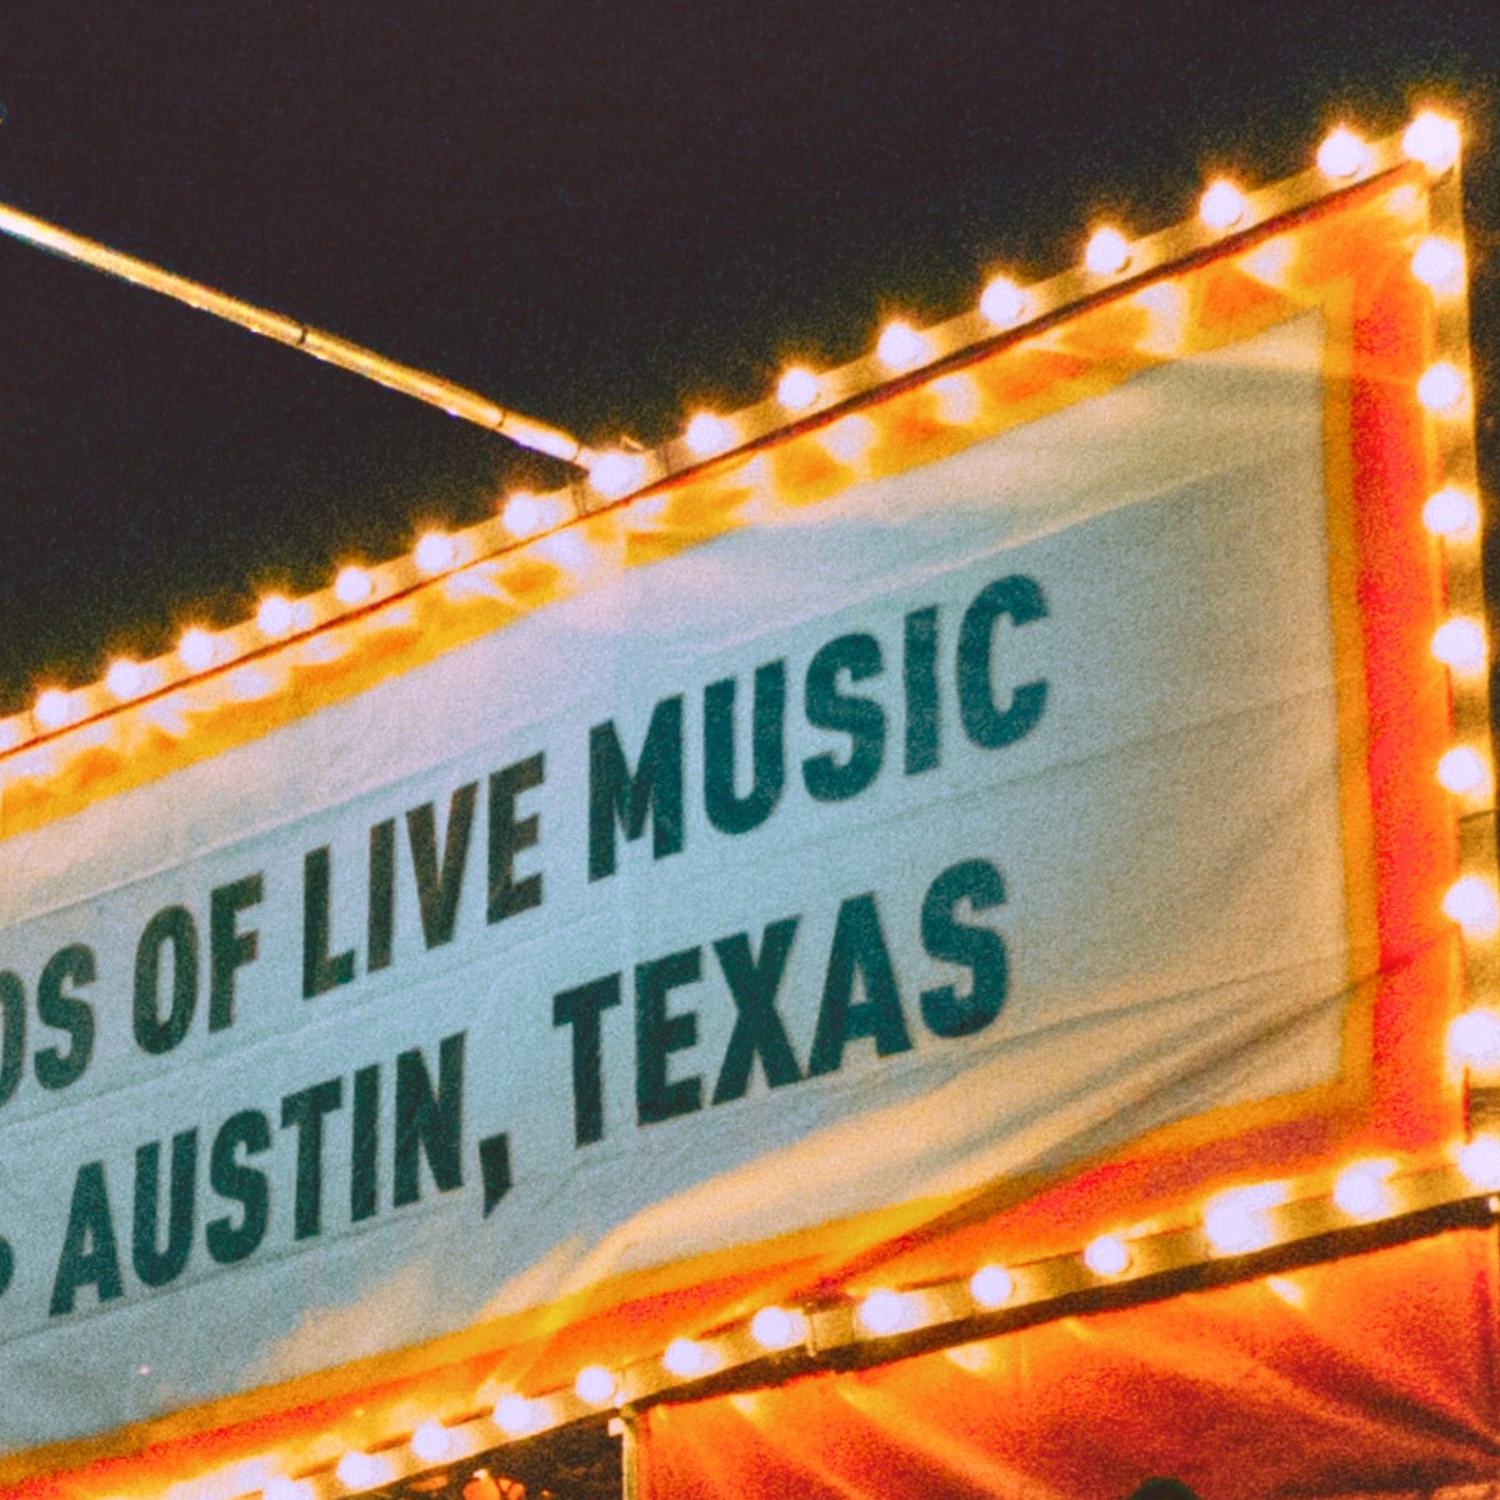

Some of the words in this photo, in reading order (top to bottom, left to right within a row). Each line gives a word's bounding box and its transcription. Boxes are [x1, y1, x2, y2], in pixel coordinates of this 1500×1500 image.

[132, 870, 264, 1055] OF
[302, 750, 546, 1001] LIVE
[588, 573, 1050, 884] MUSIC
[48, 1028, 513, 1320] AUSTIN,
[551, 857, 1010, 1150] TEXAS
